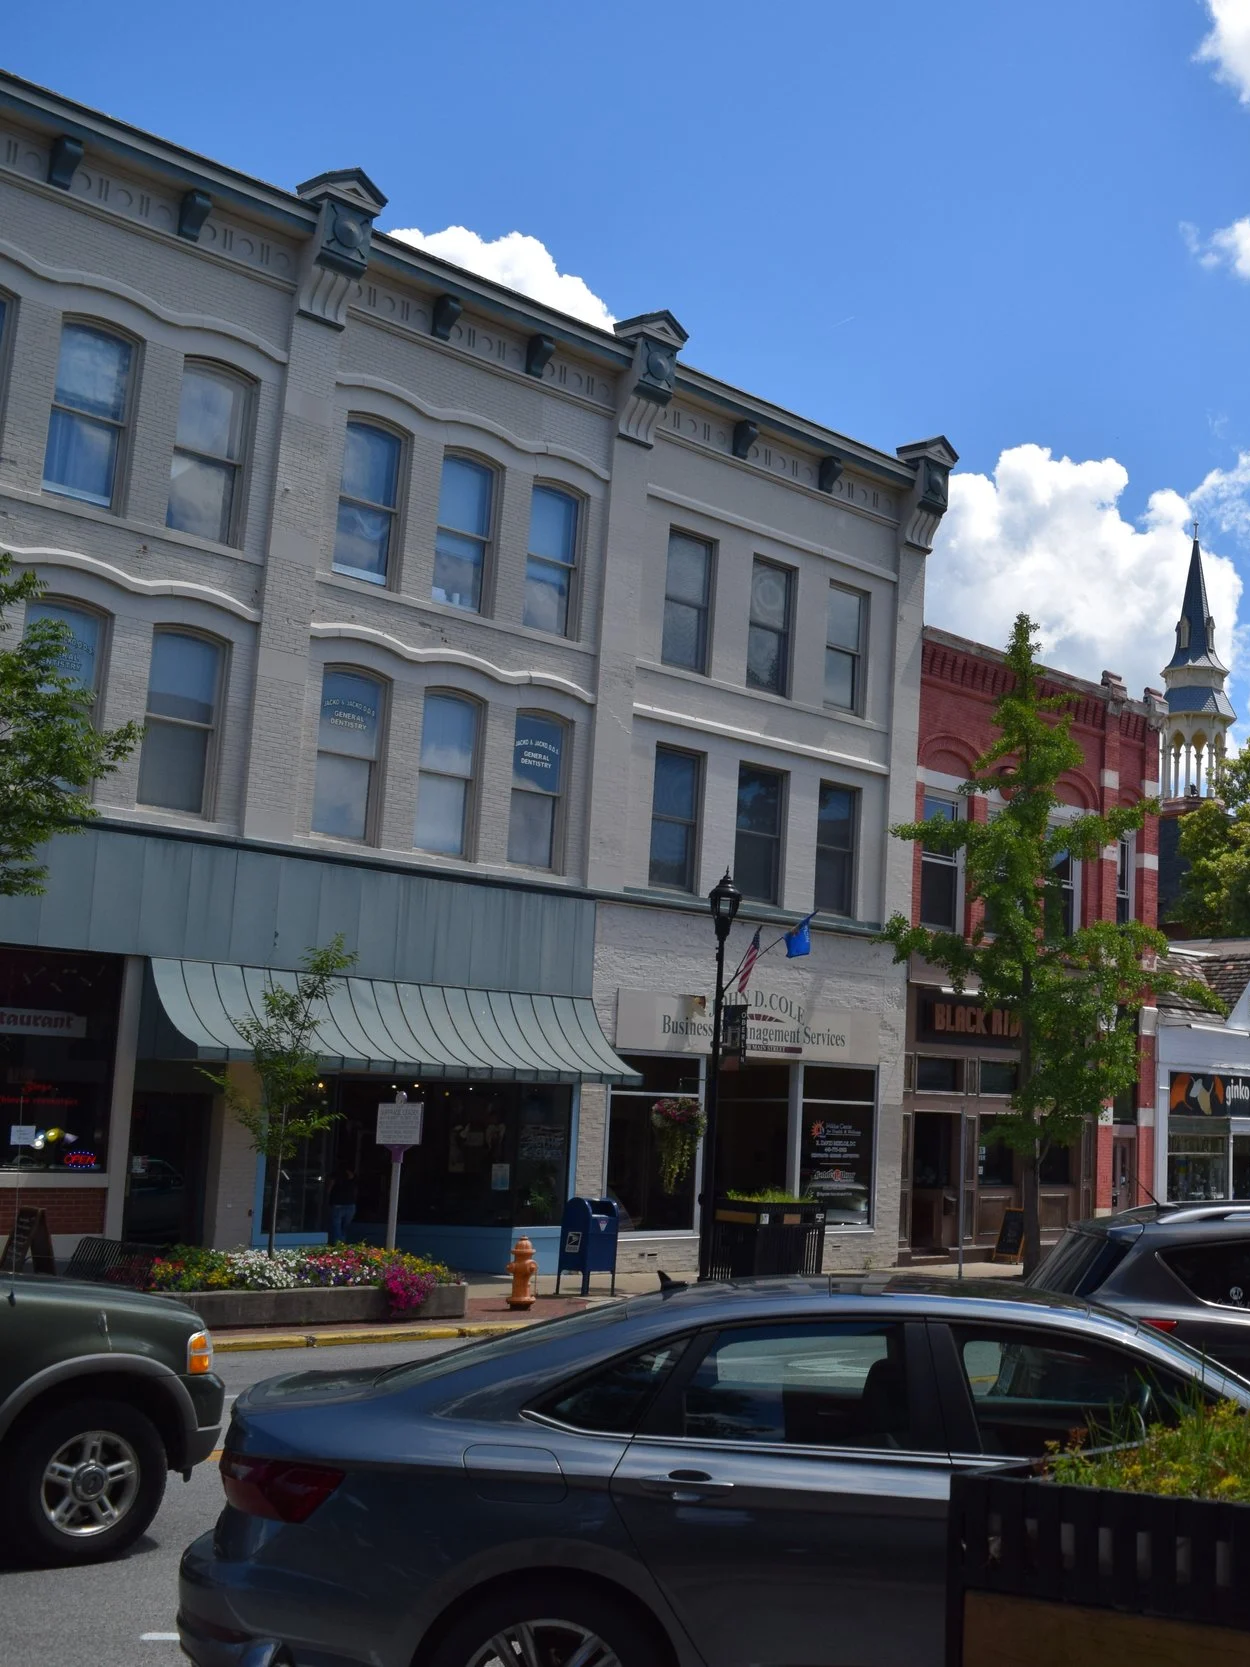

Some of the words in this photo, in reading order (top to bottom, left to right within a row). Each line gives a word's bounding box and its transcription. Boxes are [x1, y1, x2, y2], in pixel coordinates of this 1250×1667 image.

[330, 718, 367, 730] DENTISTRY
[334, 710, 365, 722] GENERAL
[521, 757, 552, 768] DENTISTRY
[524, 750, 550, 761] GENERAL
[769, 993, 806, 1026] COLE
[935, 1003, 987, 1034] BLACK
[662, 1014, 714, 1037] Business
[746, 1024, 801, 1045] nagement
[803, 1026, 846, 1048] Services
[740, 1012, 748, 1063] OBERLIN
[1225, 1078, 1250, 1106] ginko
[64, 1154, 97, 1165] OPEN
